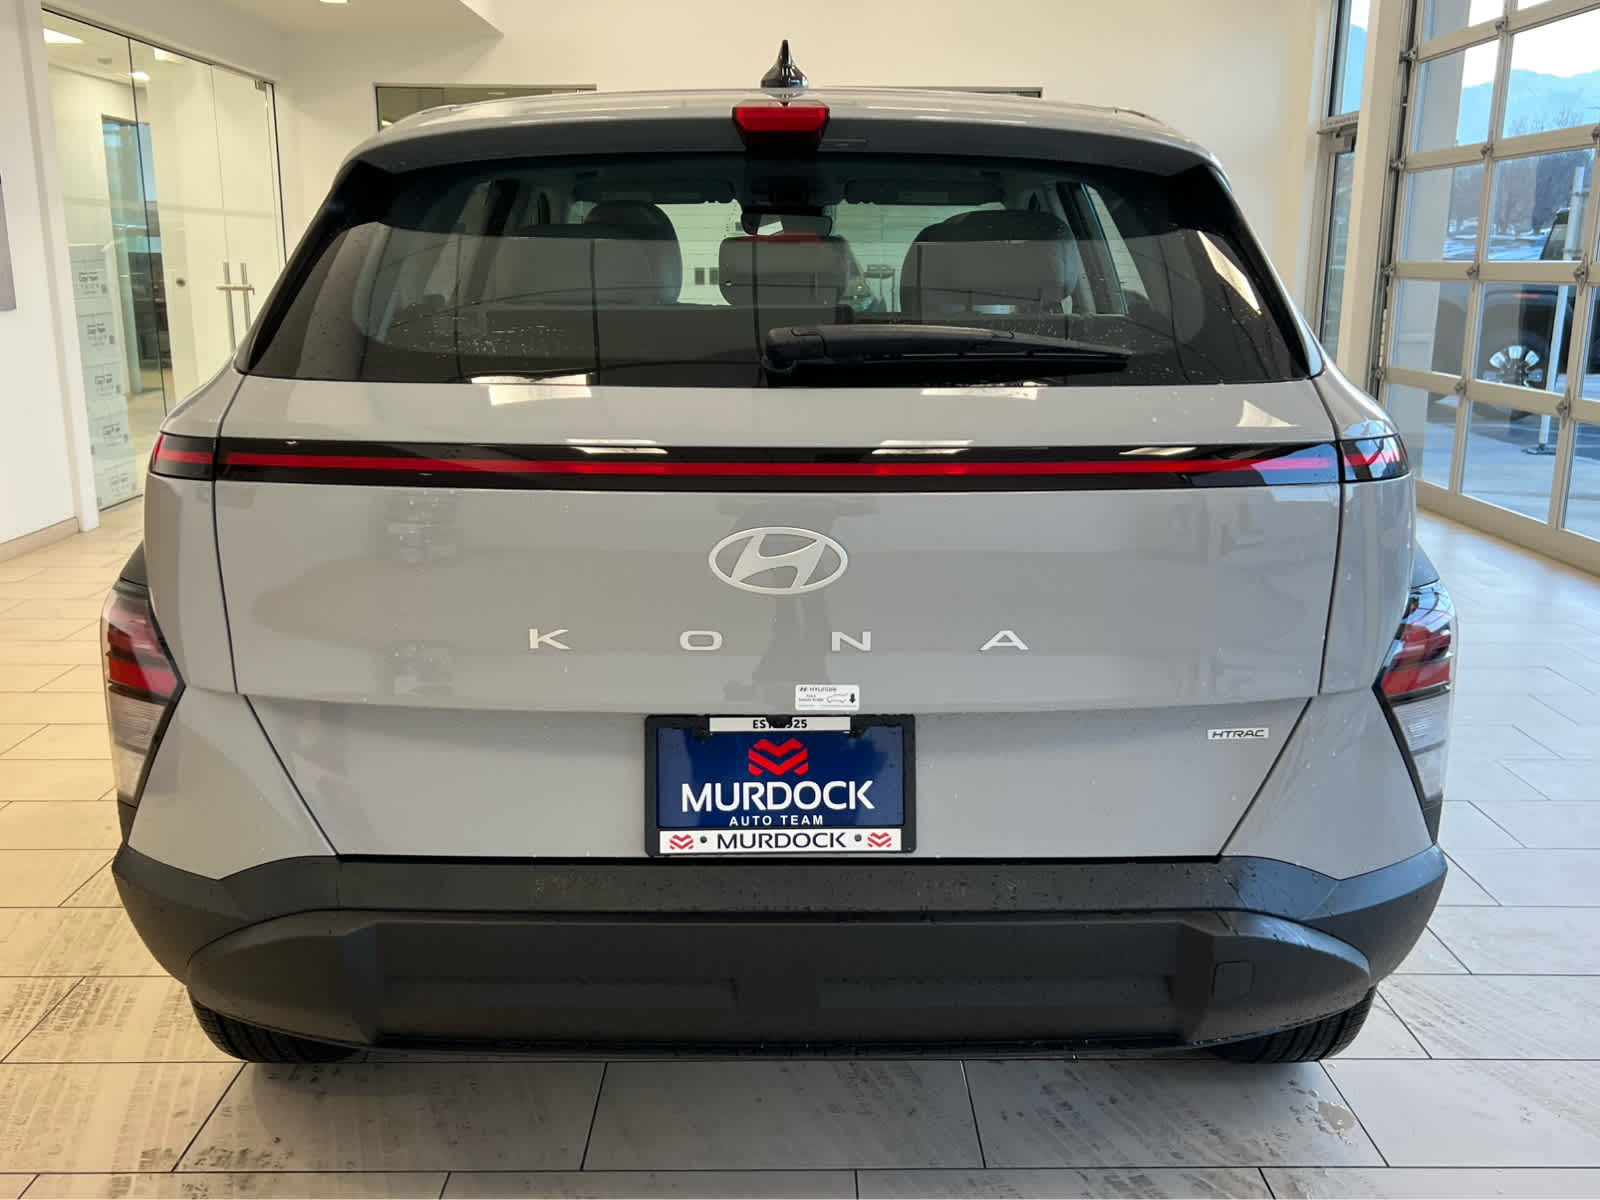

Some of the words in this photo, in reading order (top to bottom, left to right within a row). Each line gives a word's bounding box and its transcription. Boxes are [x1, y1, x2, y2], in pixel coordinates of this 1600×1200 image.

[528, 628, 1030, 652] KONA
[1211, 729, 1265, 738] HTRAC
[681, 780, 875, 812] MURDOCK
[729, 815, 772, 826] AUTO
[780, 815, 823, 825] TEAM
[717, 832, 848, 849] MURDOCK
